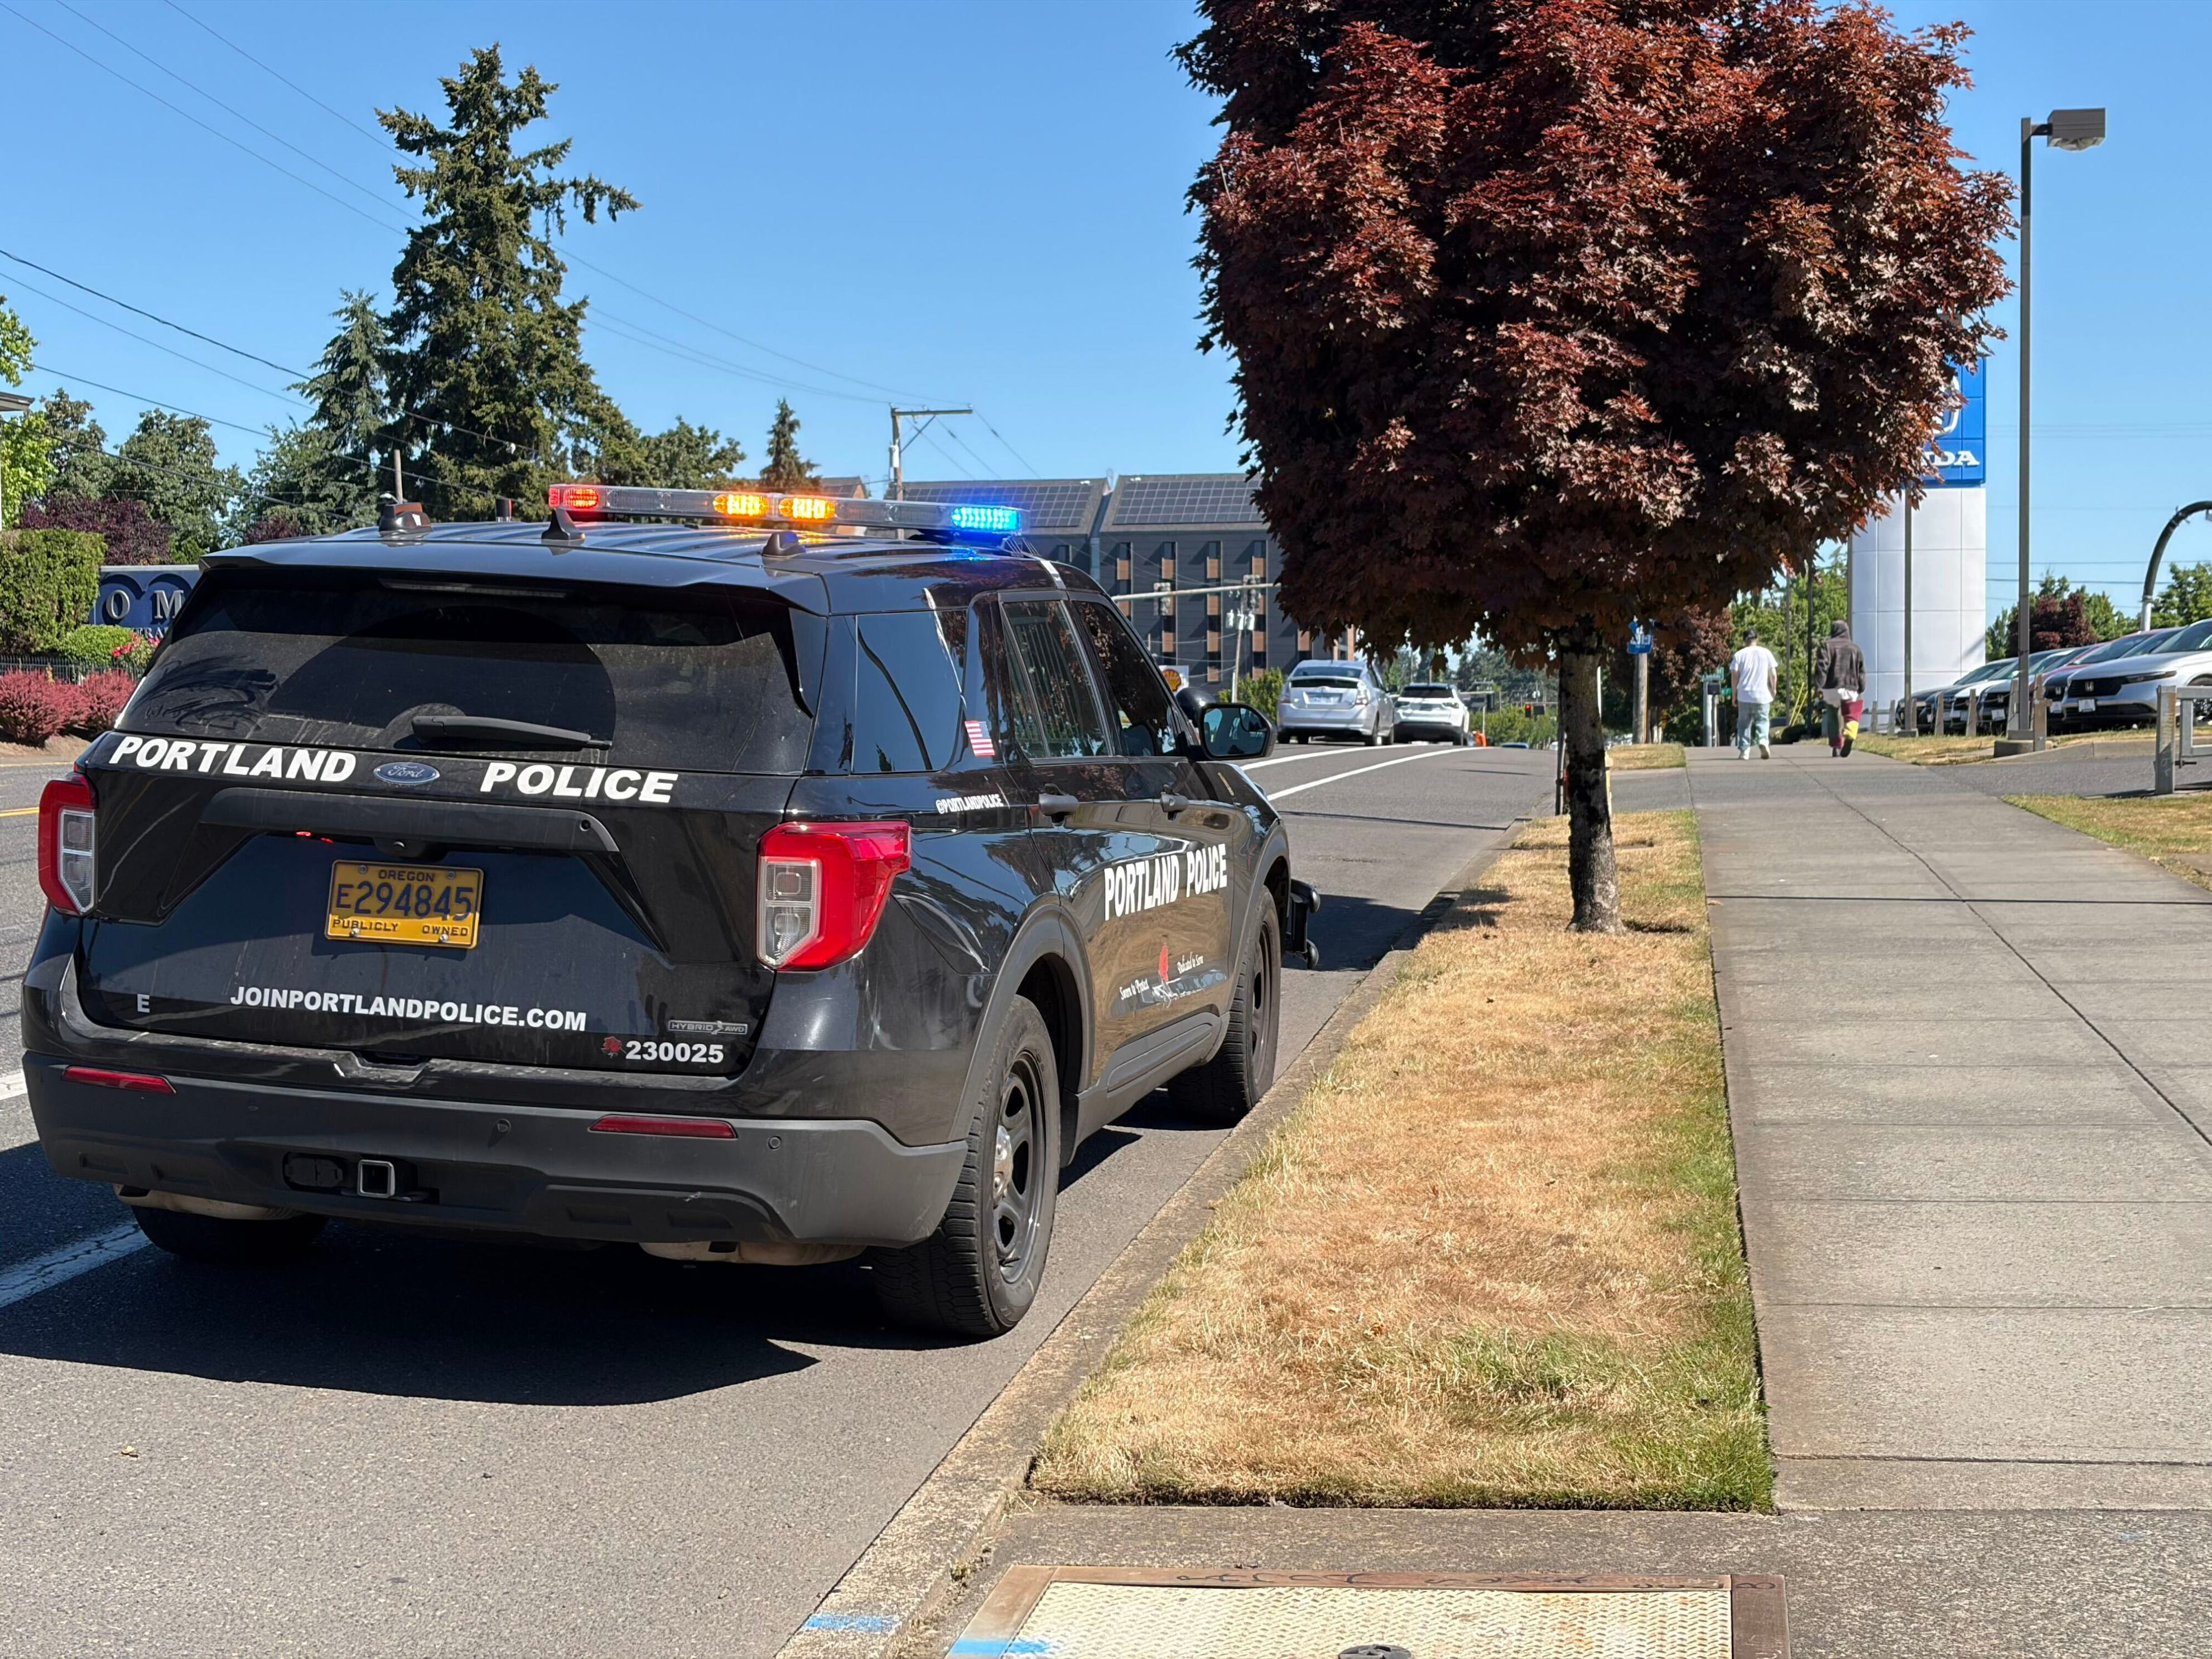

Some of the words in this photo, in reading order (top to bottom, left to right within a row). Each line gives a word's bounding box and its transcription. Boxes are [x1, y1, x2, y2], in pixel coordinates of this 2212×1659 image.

[109, 736, 356, 782] PORTLAND
[480, 762, 679, 803] POLICE
[388, 764, 426, 778] Ford
[936, 794, 1004, 814] @PORTLANDPOLICE
[378, 869, 435, 882] OREGON
[1104, 855, 1180, 922] PORTLAND
[1186, 843, 1228, 898] POLICE
[335, 881, 474, 922] E294845
[332, 919, 399, 932] PUBLICLY
[422, 924, 469, 937] OWNED
[137, 994, 151, 1014] E
[230, 986, 587, 1032] JOINPORTLANDPOLICE.COM
[671, 1022, 714, 1031] HYBRID
[625, 1040, 724, 1063] 230025
